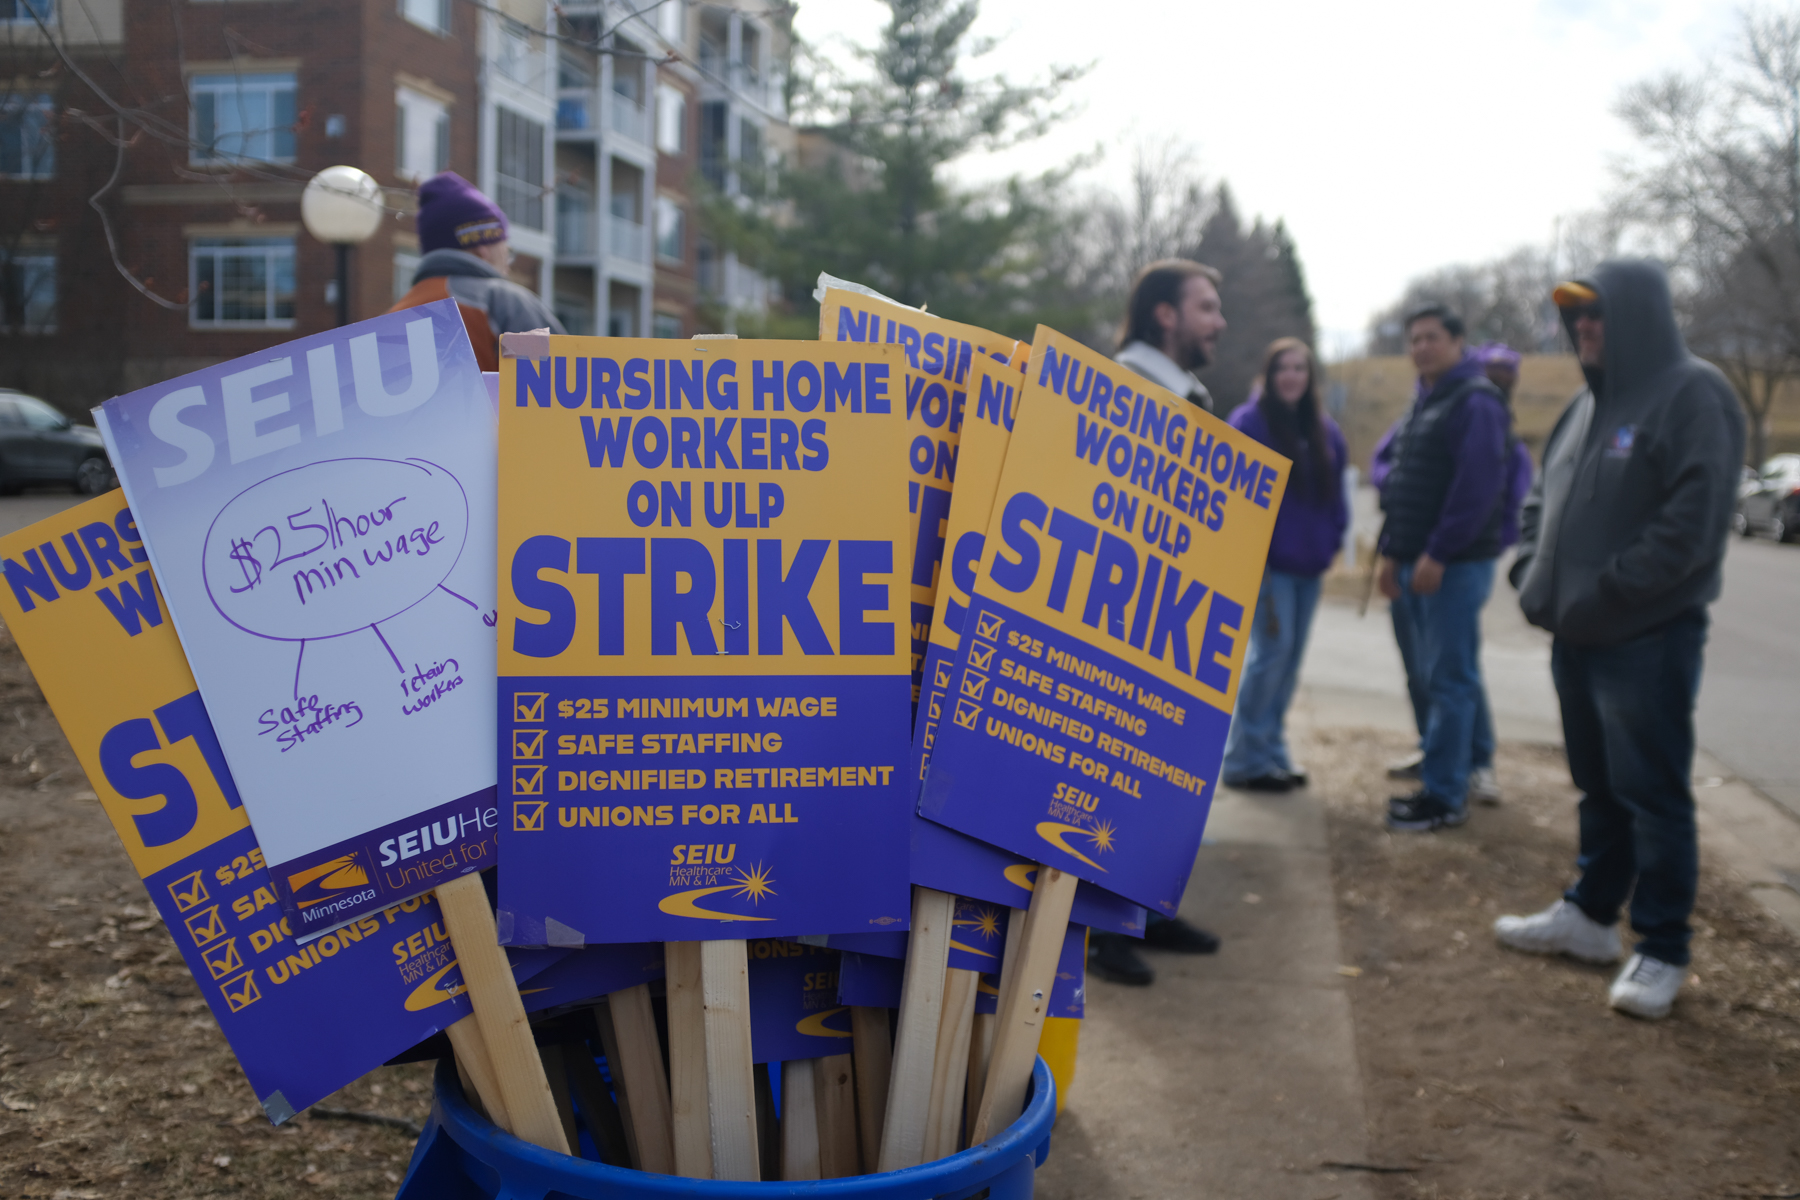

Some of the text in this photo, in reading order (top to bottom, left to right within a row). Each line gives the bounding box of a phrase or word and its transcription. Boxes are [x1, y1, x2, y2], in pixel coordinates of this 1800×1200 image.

[837, 305, 1010, 385] NURSIN
[148, 317, 440, 488] SEIU
[516, 356, 739, 411] NURSING
[752, 359, 891, 414] HOME
[579, 415, 829, 472] WORKERS
[1038, 344, 1189, 458] NURSING
[1189, 426, 1278, 510] HOME
[1075, 412, 1228, 532] WORKERS
[626, 479, 785, 529] ON ULP
[1092, 481, 1192, 559] ON ULP
[2, 507, 149, 613] NURS
[292, 520, 445, 605] min wage
[511, 534, 896, 658] STRIKE
[989, 491, 1245, 695] STRIKE
[402, 675, 463, 715] workers
[999, 658, 1147, 736] SAFE STAFFING
[1007, 630, 1186, 726] $25 MINIMUM WAGE
[557, 697, 837, 719] $25 MINIMUM WAGE
[557, 732, 783, 755] SAFE STAFFING
[985, 716, 1142, 799] UNIONS FOR ALL
[992, 686, 1207, 795] DIGNIFIED RETIREMENT
[558, 766, 894, 792] DIGNIFIED RETIREMENT
[1053, 782, 1100, 812] SEIU
[558, 803, 798, 828] UNIONS FOR ALL
[1047, 806, 1064, 819] MN
[1050, 798, 1093, 822] Healthcare
[379, 807, 498, 867] SEIUHe
[670, 843, 736, 865] SEIU
[215, 847, 266, 886] $25
[385, 840, 487, 889] United for
[669, 866, 733, 877] Healthcare
[669, 875, 717, 886] MN & IA
[231, 882, 278, 921] SA
[302, 888, 376, 923] Minnesota
[265, 917, 380, 984] UNIONS
[392, 918, 450, 965] SEIU
[399, 941, 454, 976] Healthcar
[747, 940, 803, 960] IONS
[403, 954, 449, 985] MN & IA
